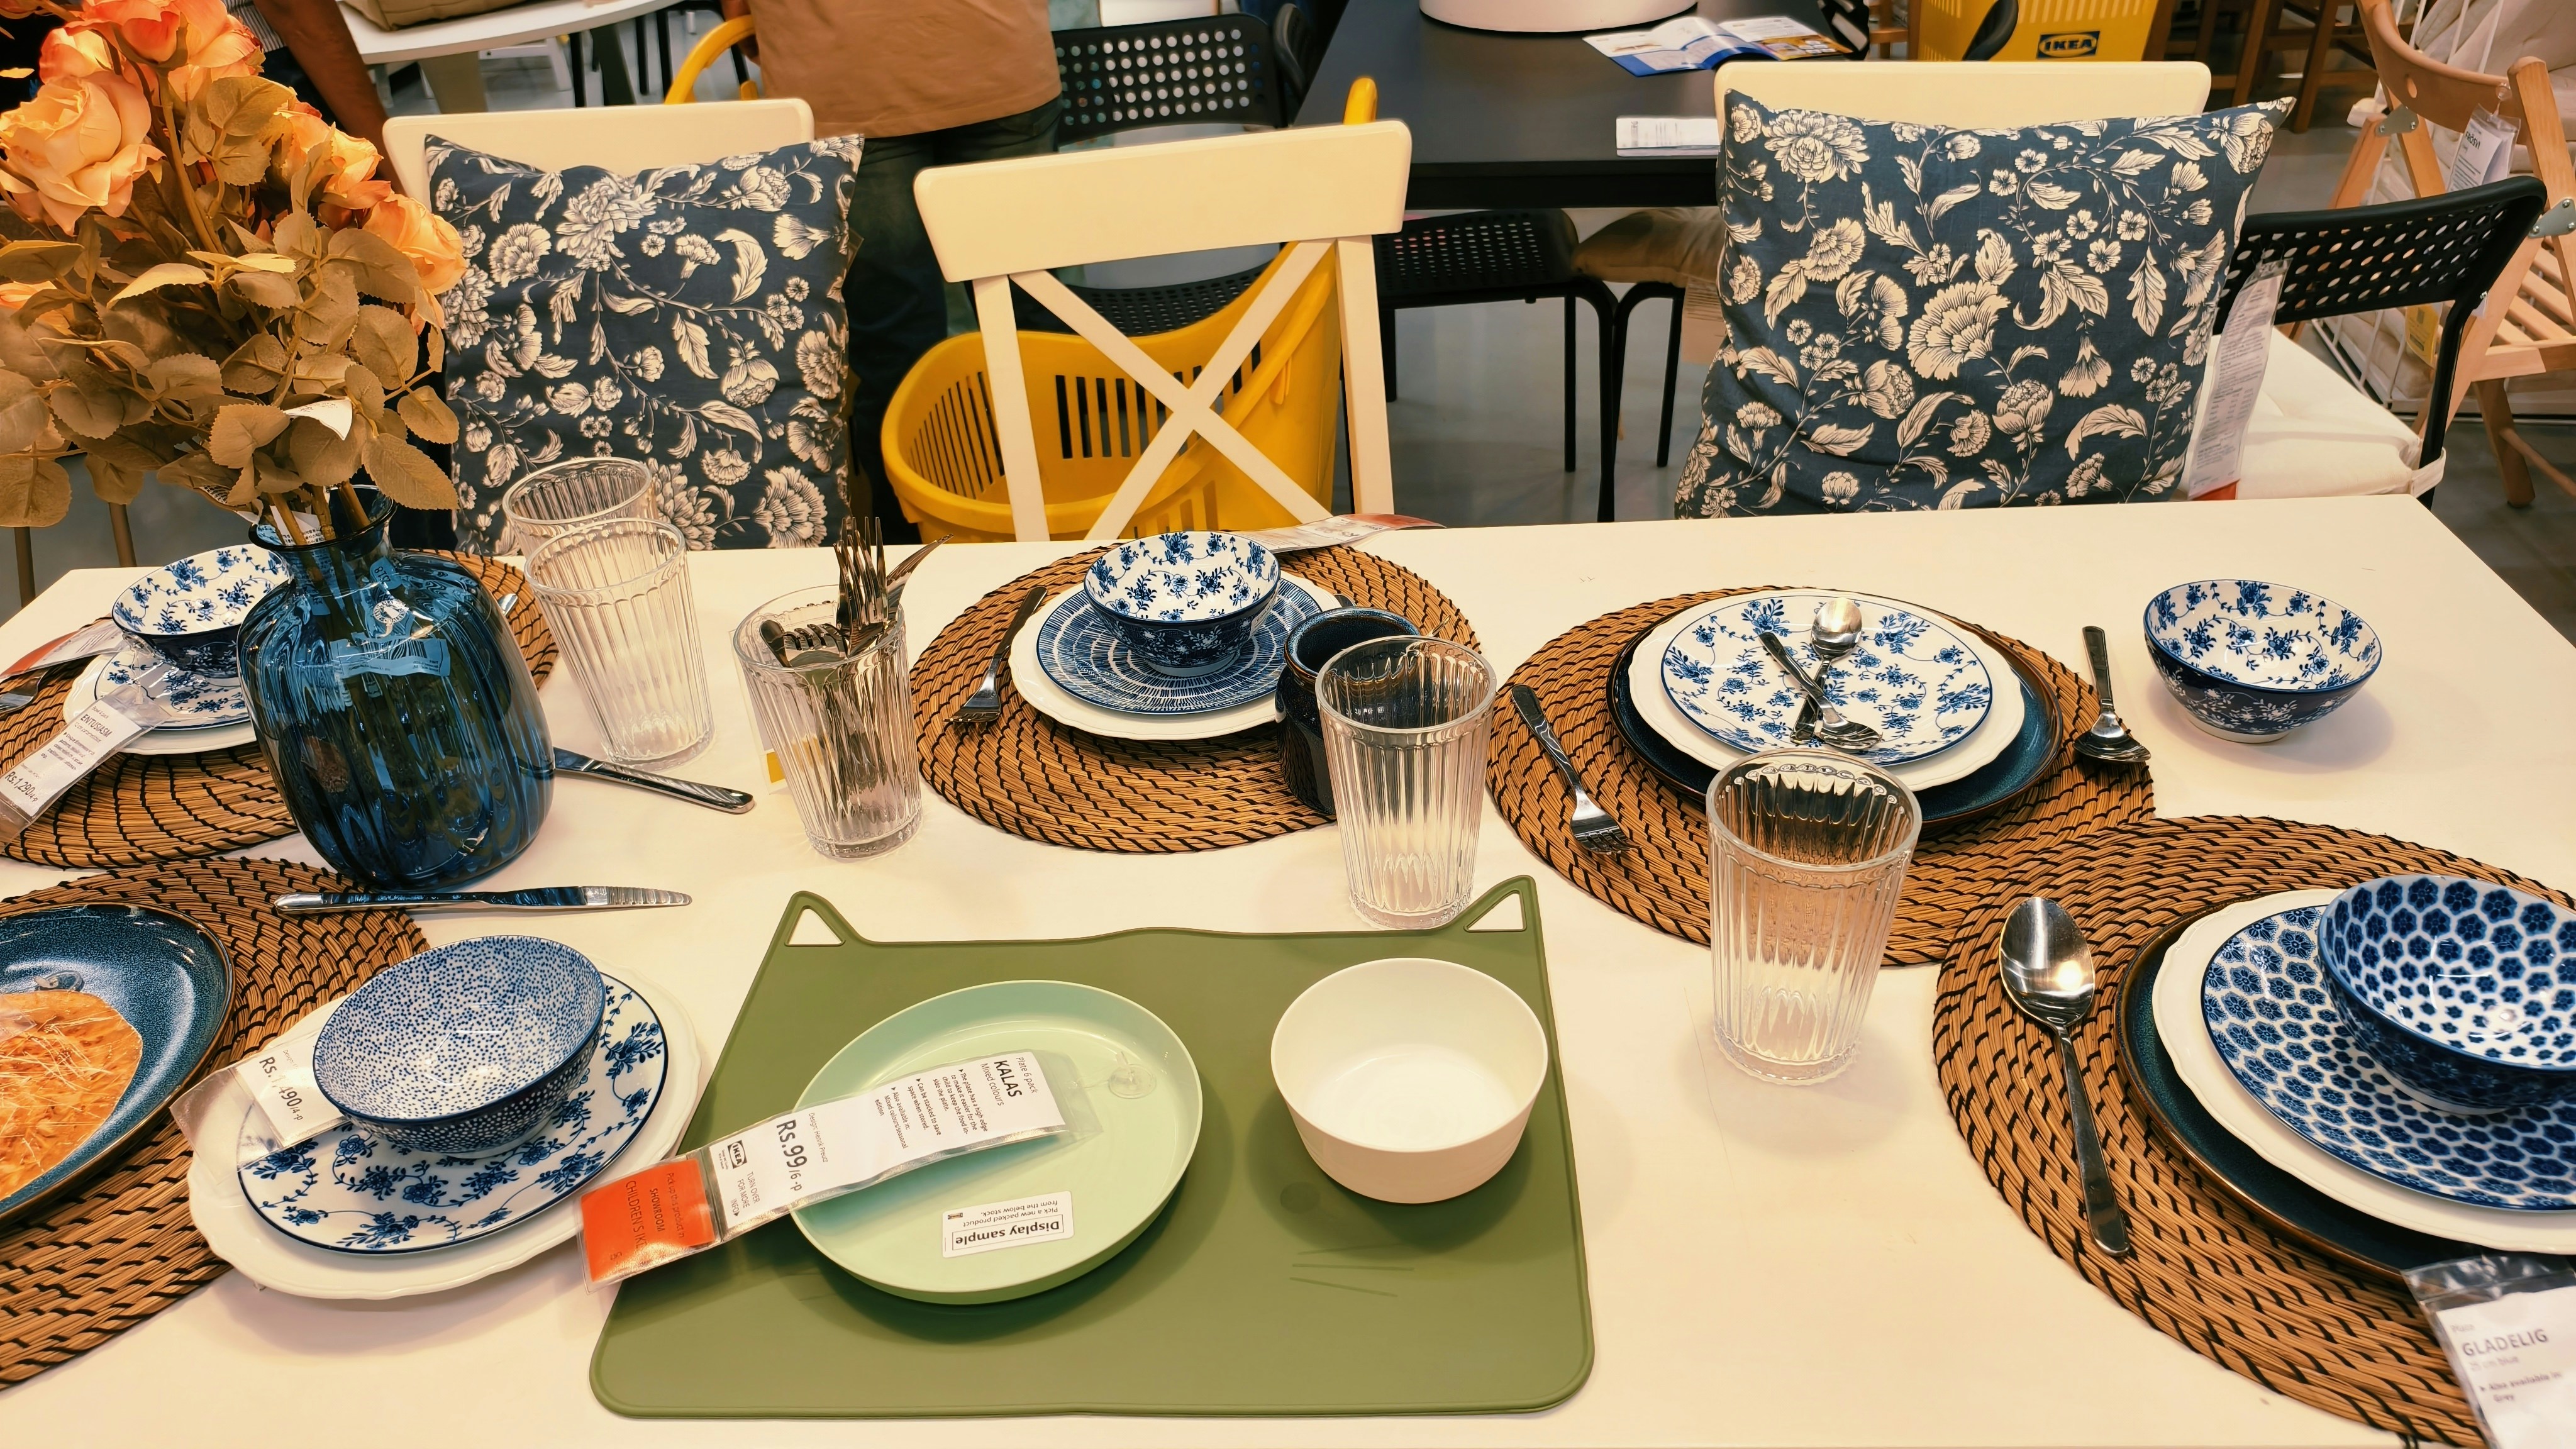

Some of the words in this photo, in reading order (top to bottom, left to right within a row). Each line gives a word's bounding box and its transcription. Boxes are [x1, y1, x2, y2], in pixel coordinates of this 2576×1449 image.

[2045, 39, 2092, 50] IKEA
[80, 714, 113, 738] ENTUSIASM
[980, 1063, 996, 1081] Mixed
[989, 1082, 1004, 1106] colours
[994, 1060, 1023, 1097] KALAS
[1016, 1057, 1028, 1072] Plate
[1023, 1078, 1038, 1093] pack
[933, 1079, 941, 1088] side
[938, 1097, 949, 1111] plate.
[942, 1076, 952, 1088] child
[949, 1094, 958, 1106] keep
[958, 1115, 967, 1127] food
[953, 1080, 962, 1093] make
[960, 1098, 970, 1113] easier
[962, 1081, 972, 1094] plate
[974, 1107, 984, 1118] high
[979, 1119, 988, 1131] edge
[875, 1099, 884, 1116] edition
[892, 1092, 900, 1102] Also
[896, 1102, 908, 1123] available
[907, 1085, 917, 1099] space
[913, 1099, 922, 1113] when
[918, 1113, 930, 1130] stored.
[923, 1099, 936, 1118] stacked
[933, 1124, 941, 1135] save
[884, 1095, 894, 1110] Mixed
[889, 1109, 909, 1149] colours/seasonal
[732, 1144, 743, 1165] IKEA
[667, 1172, 675, 1185] Pick
[667, 1185, 675, 1194] up
[737, 1179, 746, 1192] FOR
[747, 1171, 756, 1188] TURN
[625, 1180, 644, 1233] CHILDREN'S
[731, 1198, 740, 1213] INFO
[740, 1191, 750, 1208] MORE
[750, 1187, 760, 1204] OVER
[649, 1188, 665, 1231] SHOWROOM
[671, 1206, 684, 1231] product
[980, 1209, 1001, 1217] stock.
[992, 1212, 1019, 1223] packed
[963, 1217, 991, 1227] product
[1009, 1221, 1059, 1235] Display
[955, 1230, 1005, 1245] sample
[2462, 1328, 2549, 1357] GLADELIG
